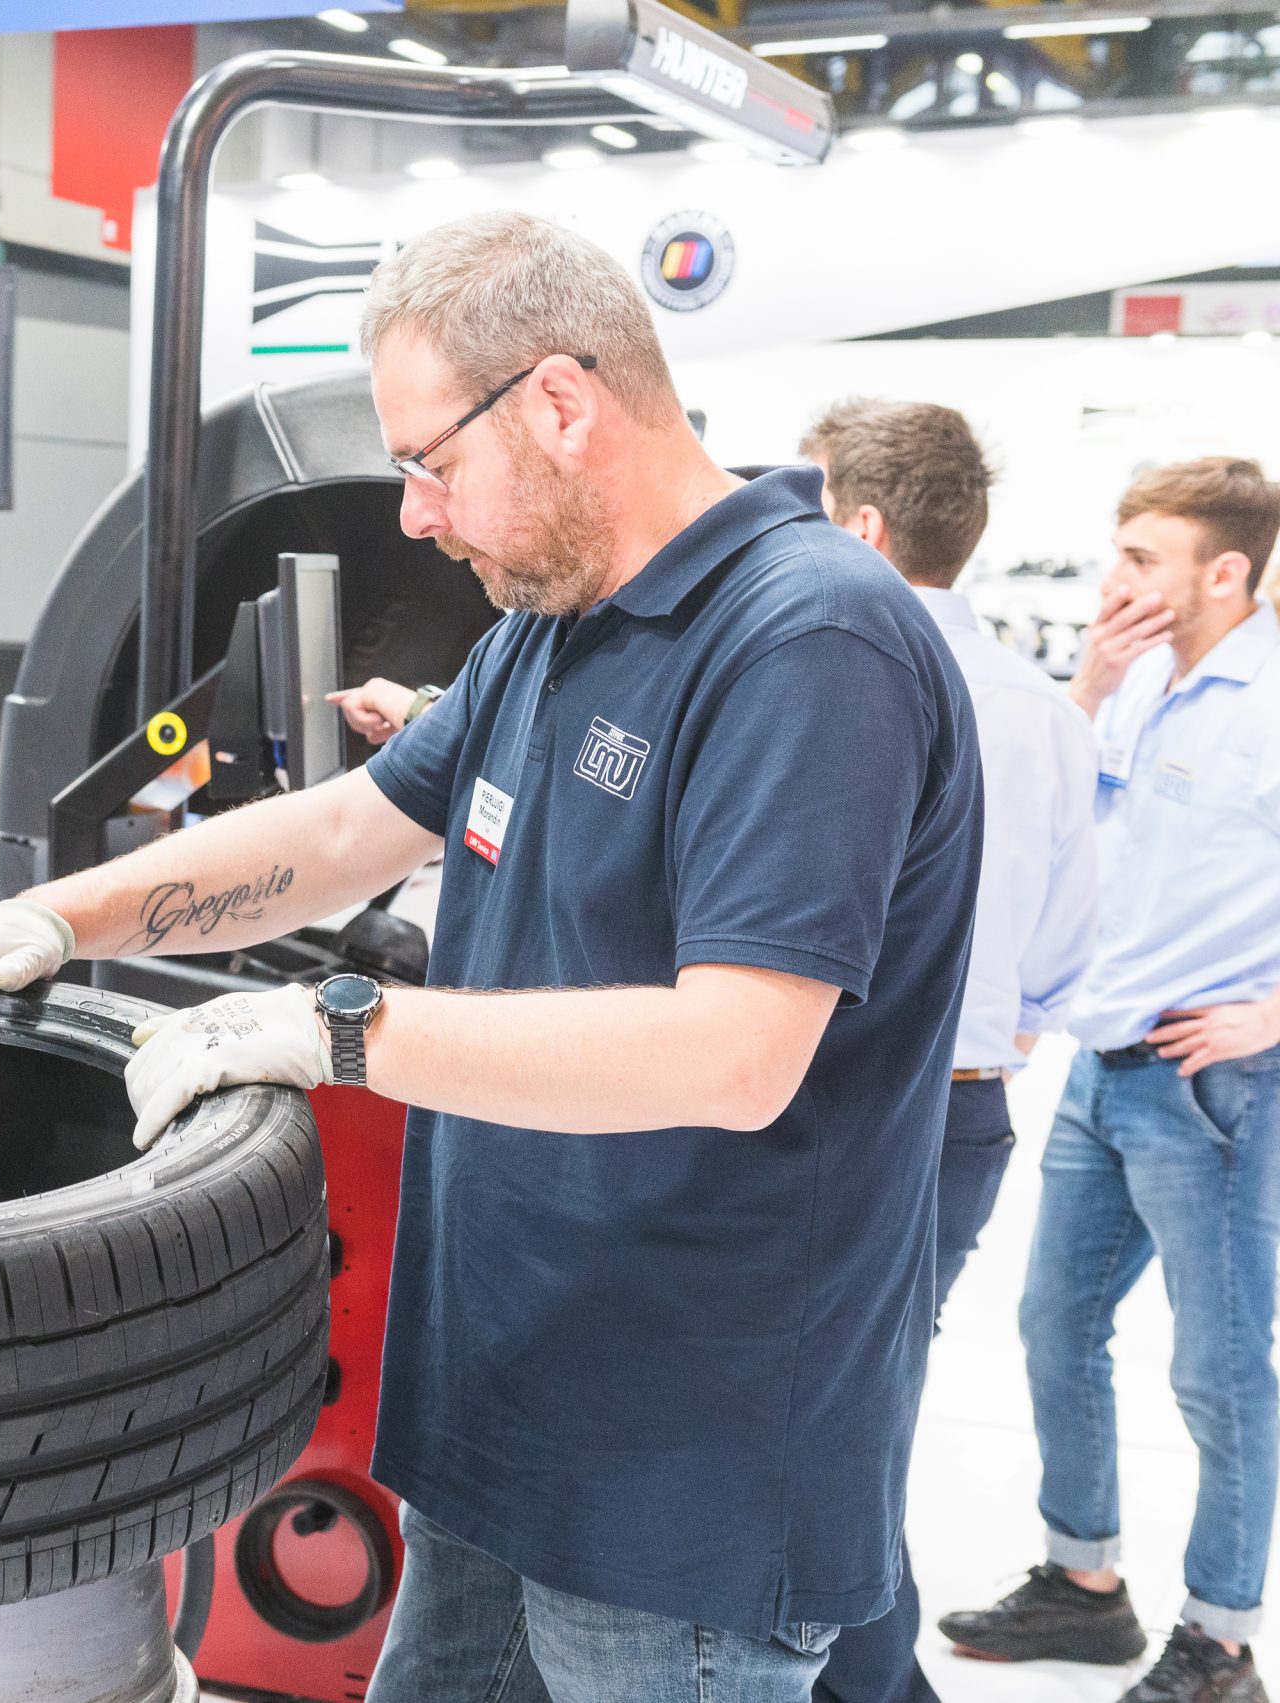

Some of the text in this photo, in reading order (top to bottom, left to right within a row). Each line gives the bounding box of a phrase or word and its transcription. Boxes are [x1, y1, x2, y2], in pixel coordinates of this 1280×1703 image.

[651, 26, 748, 110] HUNTER
[115, 864, 295, 957] Gregorio
[212, 1122, 250, 1151] OUTSIDE
